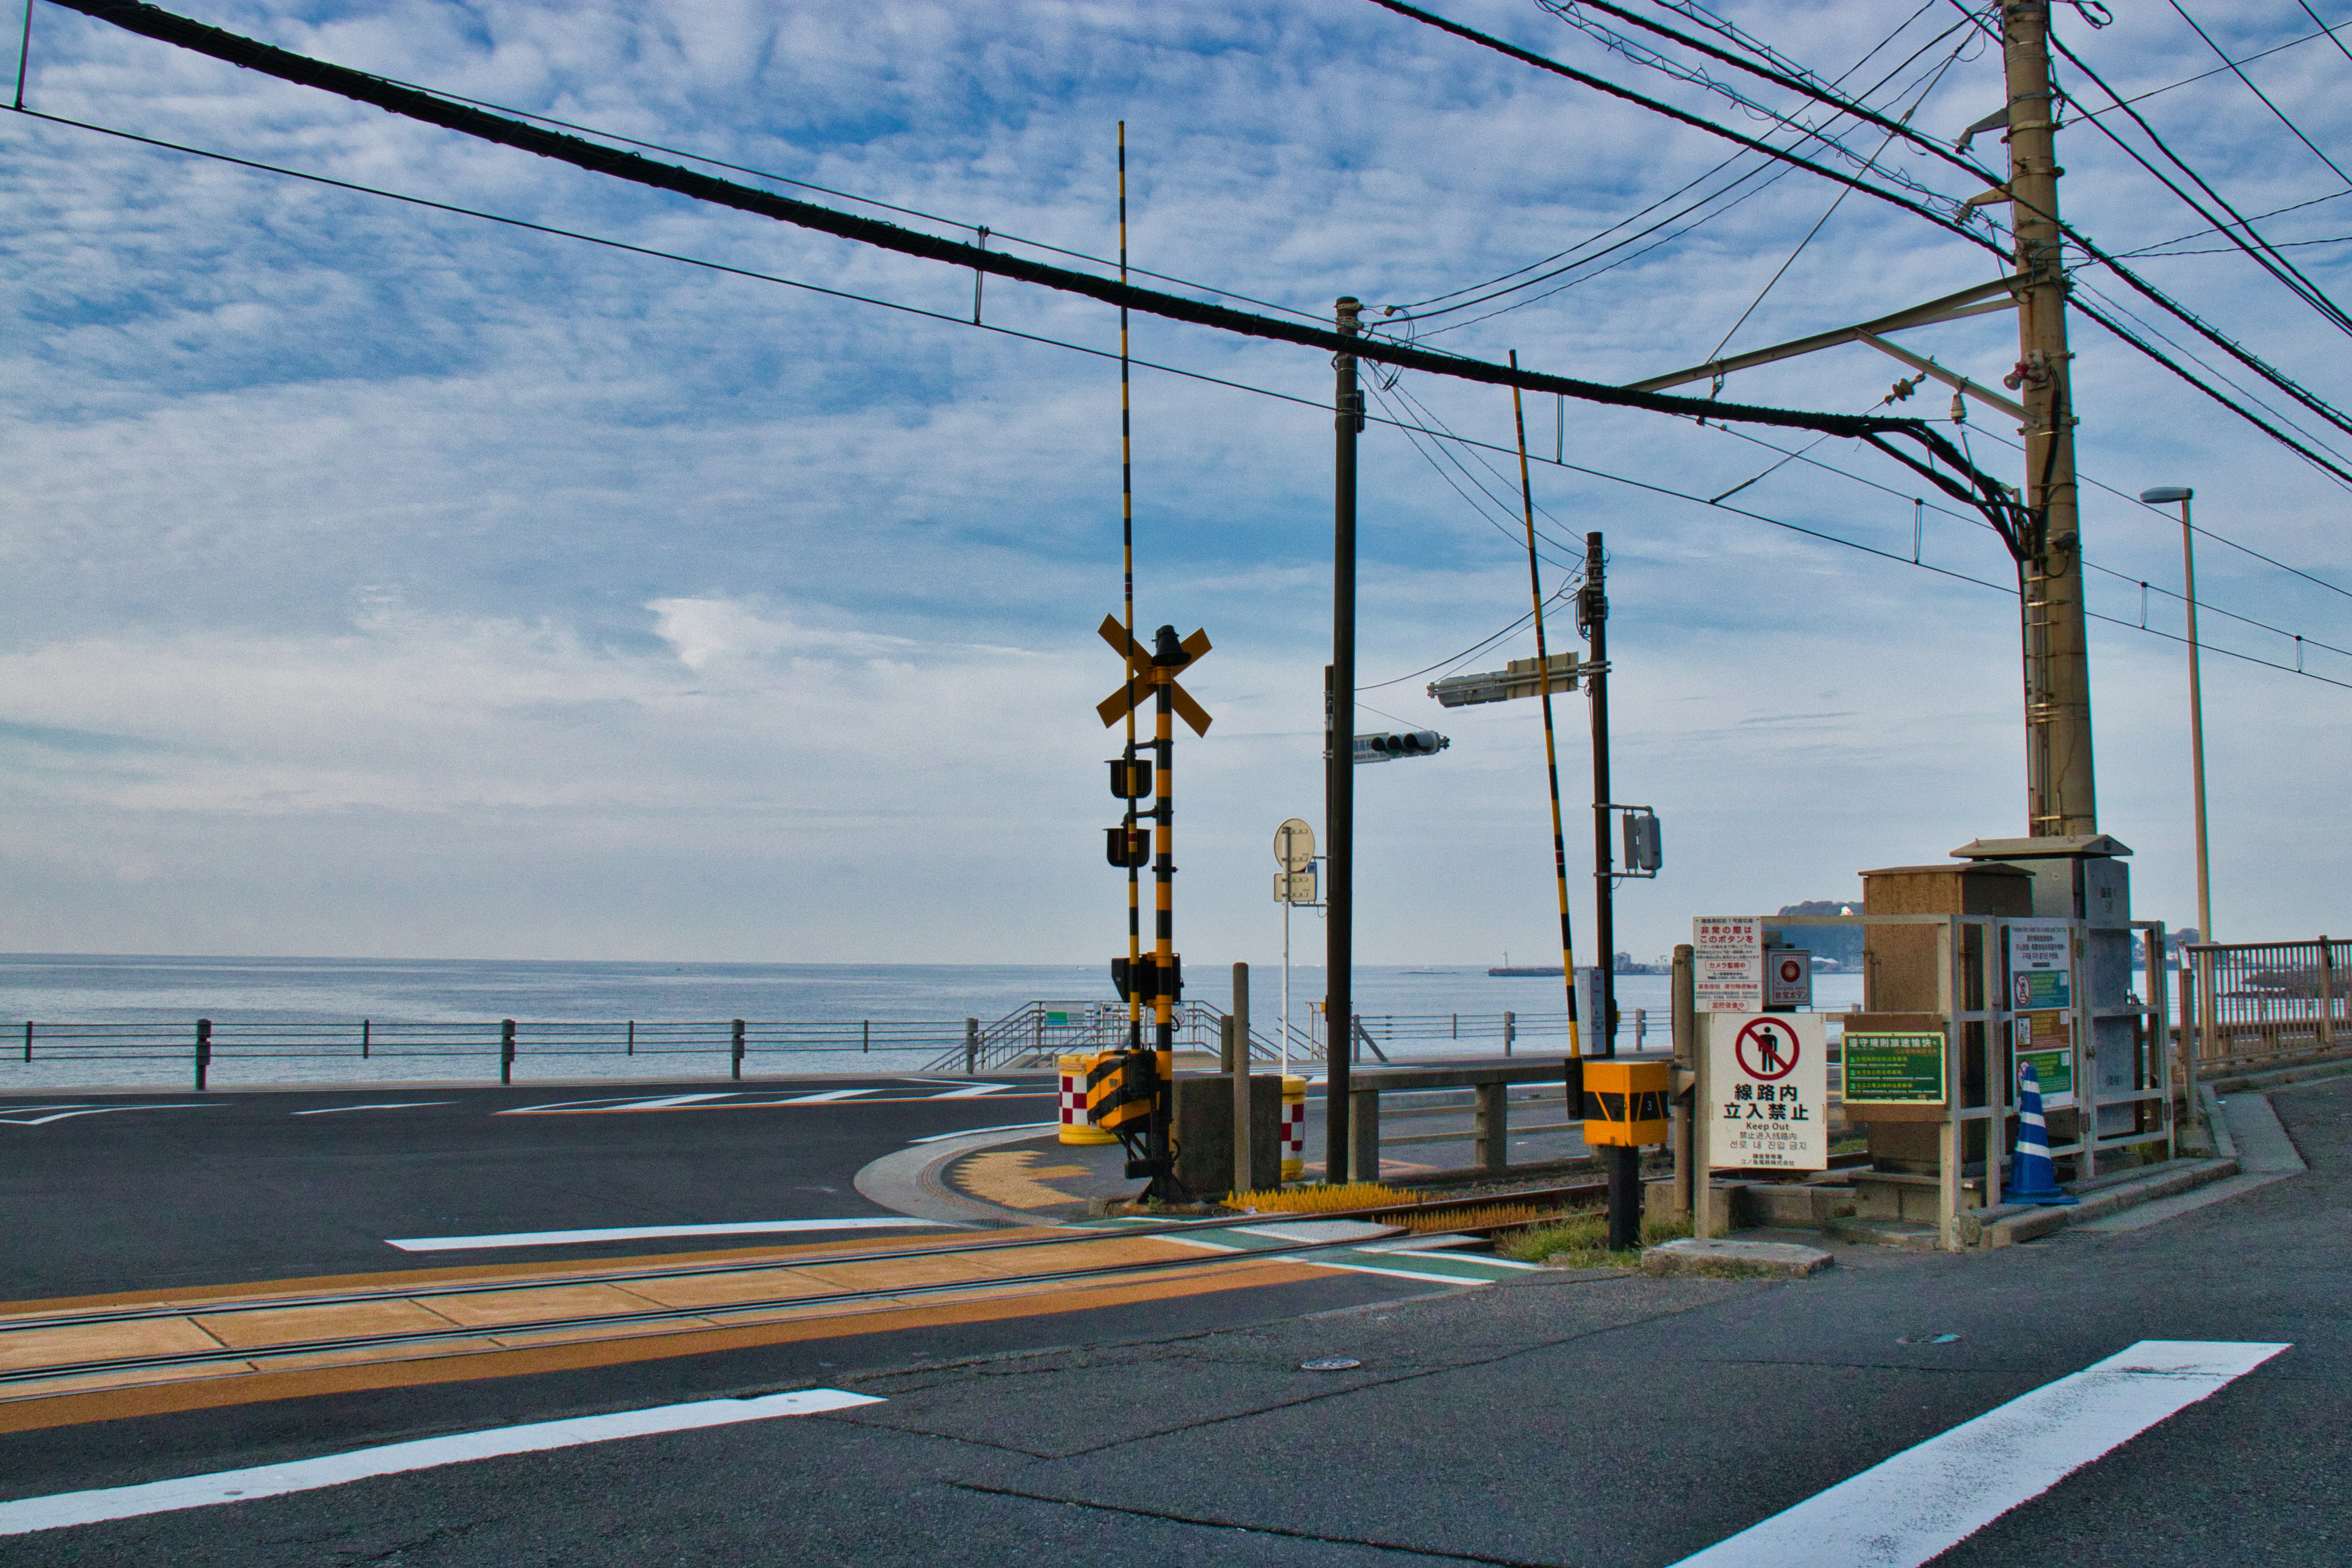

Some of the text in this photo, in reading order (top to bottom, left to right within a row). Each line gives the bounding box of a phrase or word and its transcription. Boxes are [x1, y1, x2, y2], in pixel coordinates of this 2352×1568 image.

[1700, 926, 1752, 934] 非常の際は
[1775, 991, 1807, 999] 非常ボタン
[1734, 1083, 1797, 1102] 線路内
[1647, 1100, 1652, 1111] 3
[1723, 1102, 1809, 1120] 立入禁止
[1746, 1122, 1769, 1131] Keep
[1730, 1140, 1806, 1150] 선로 내 진입 금지
